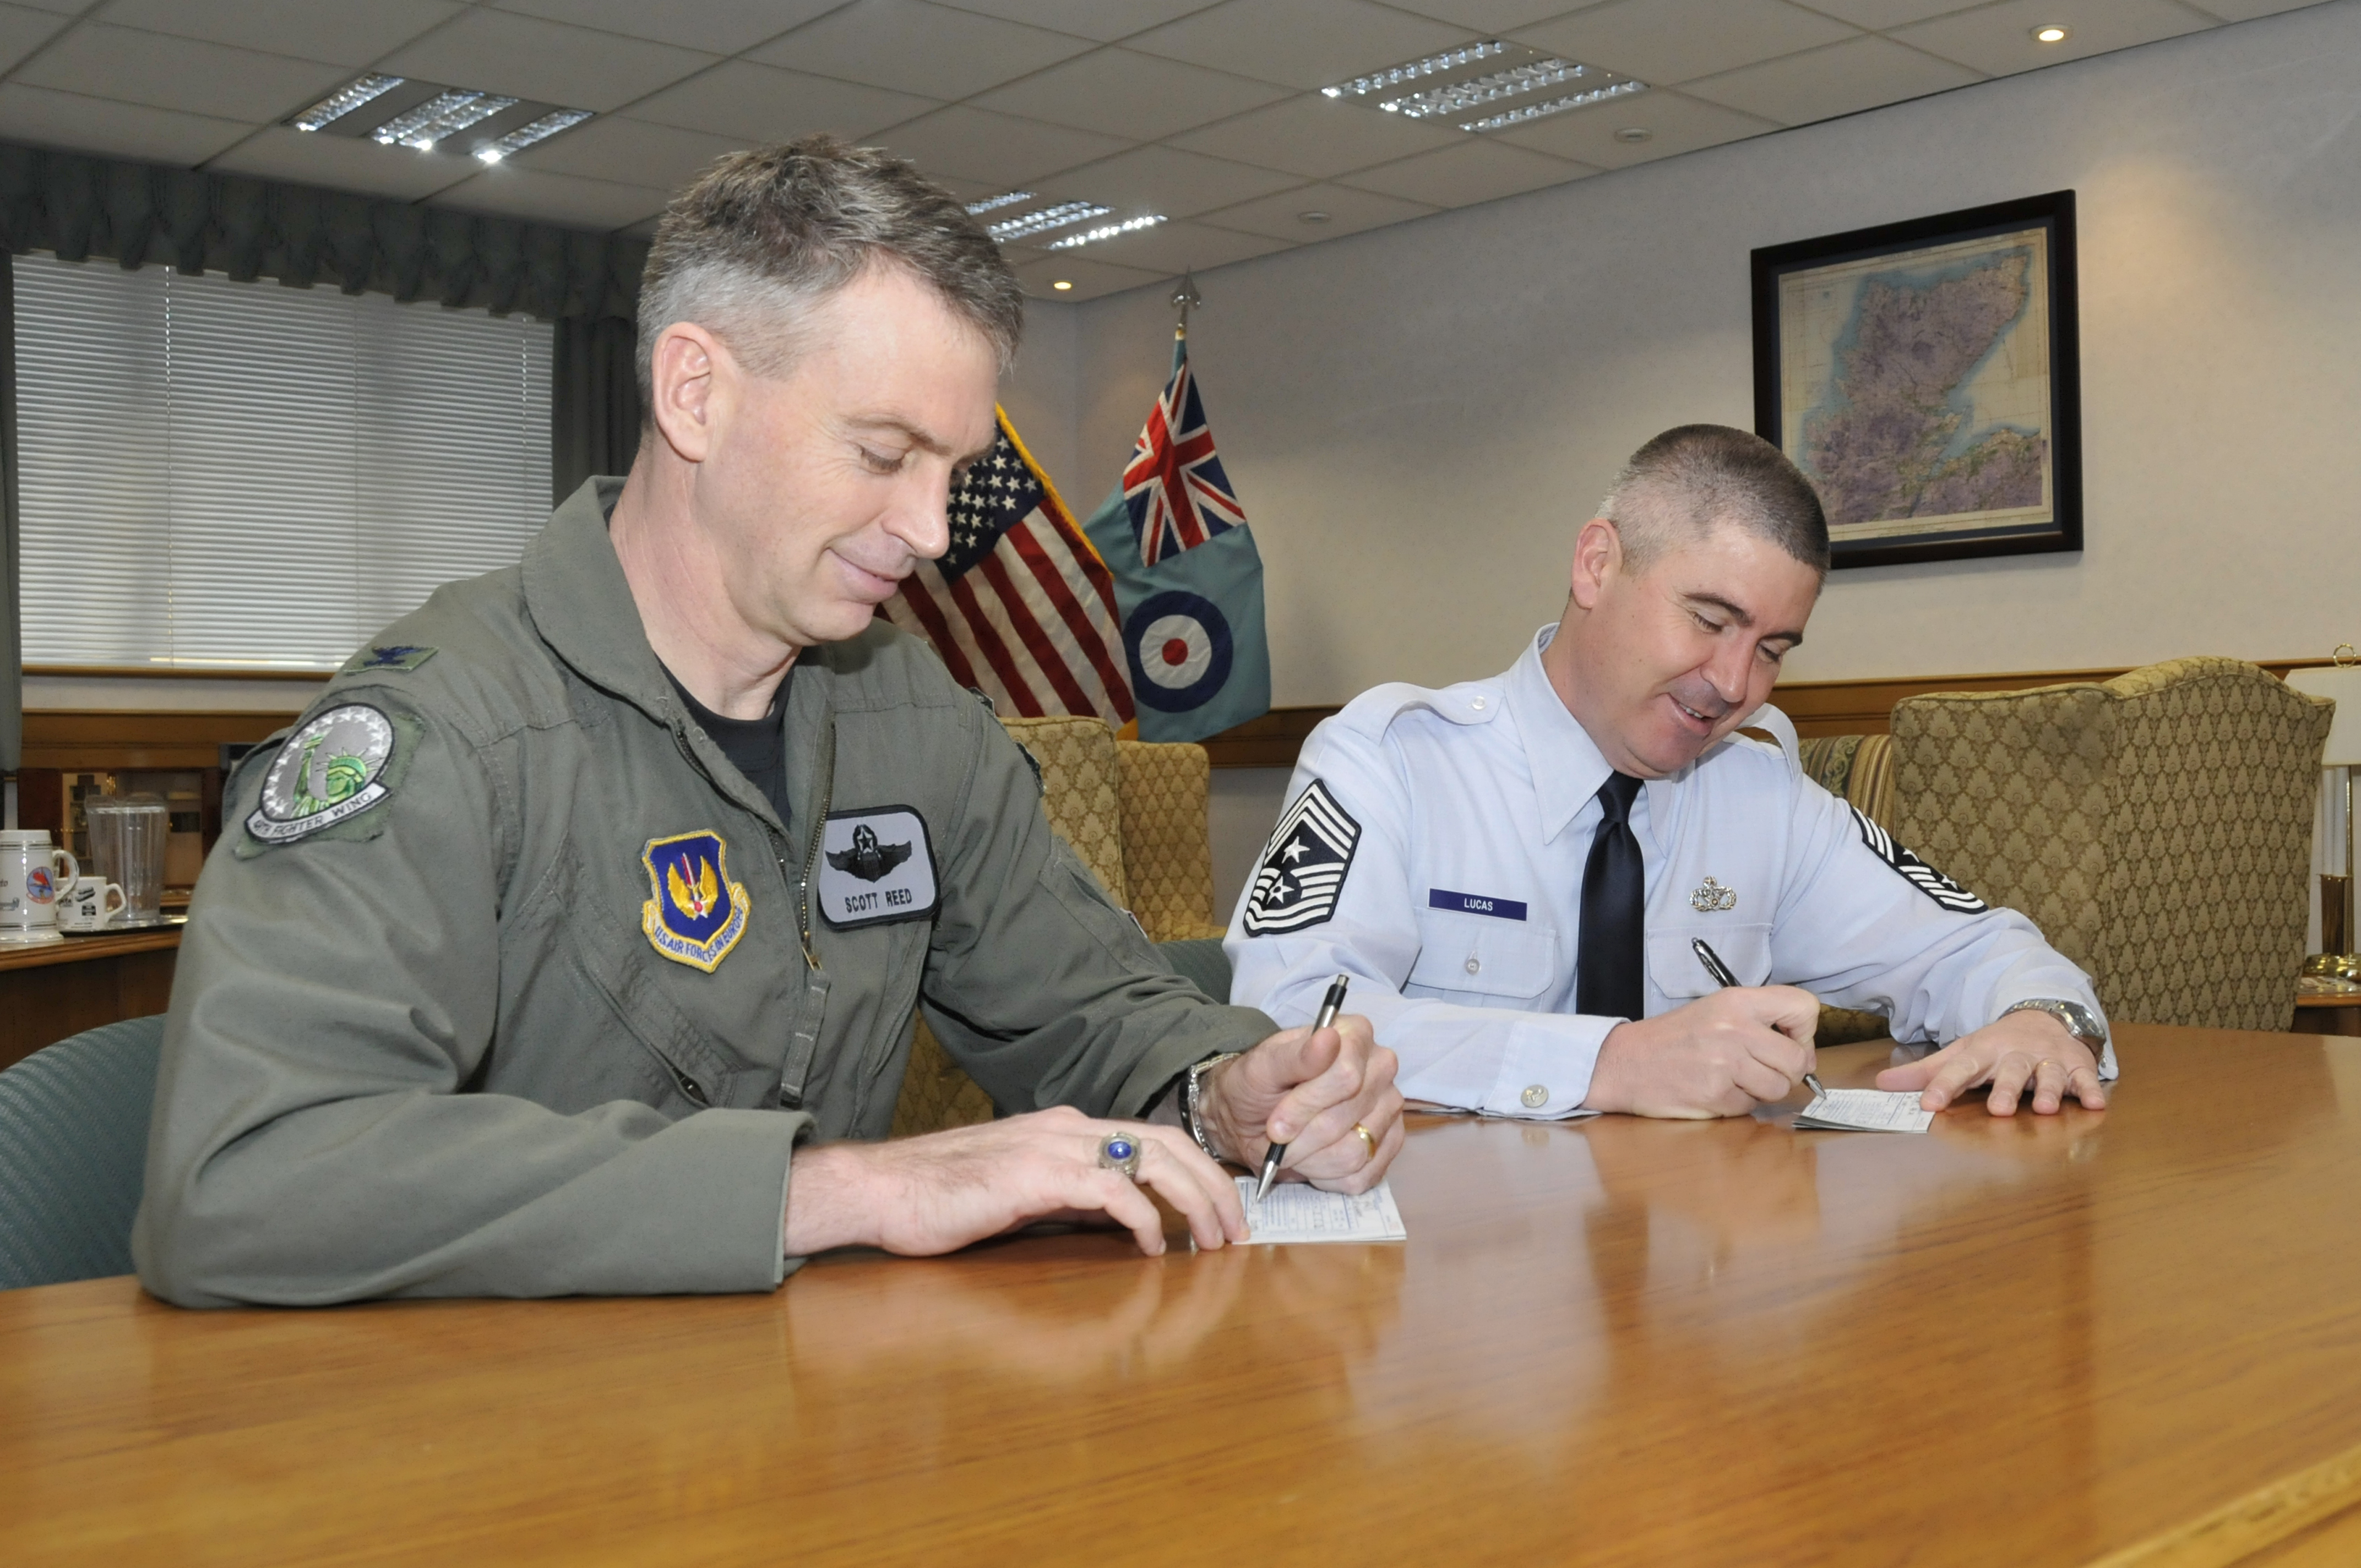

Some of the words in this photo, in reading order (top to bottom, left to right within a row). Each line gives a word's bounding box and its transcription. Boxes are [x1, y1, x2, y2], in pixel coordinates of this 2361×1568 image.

[271, 816, 323, 836] FIGHTER
[331, 793, 372, 817] WING
[845, 892, 878, 913] SCOTT
[885, 888, 912, 907] REED
[1464, 897, 1493, 911] LUCAS
[666, 939, 684, 954] AIR
[686, 943, 716, 963] FORCES
[715, 938, 724, 951] IN
[723, 905, 743, 943] EUROPE
